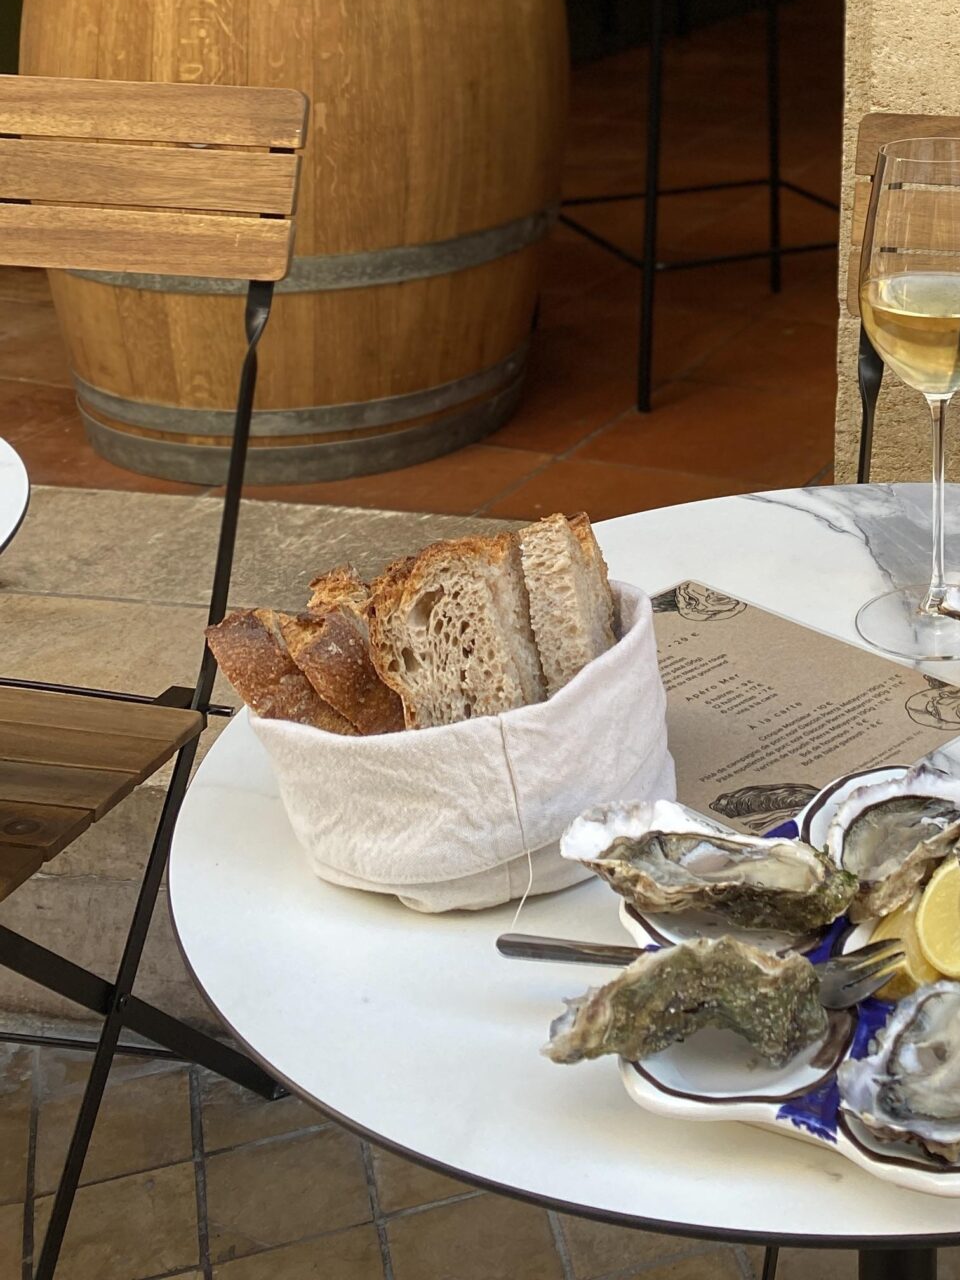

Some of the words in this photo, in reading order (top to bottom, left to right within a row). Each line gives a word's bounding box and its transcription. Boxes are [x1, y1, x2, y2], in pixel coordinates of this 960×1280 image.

[685, 685, 717, 702] Apéro
[718, 674, 739, 684] Mer
[774, 702, 802, 717] carte
